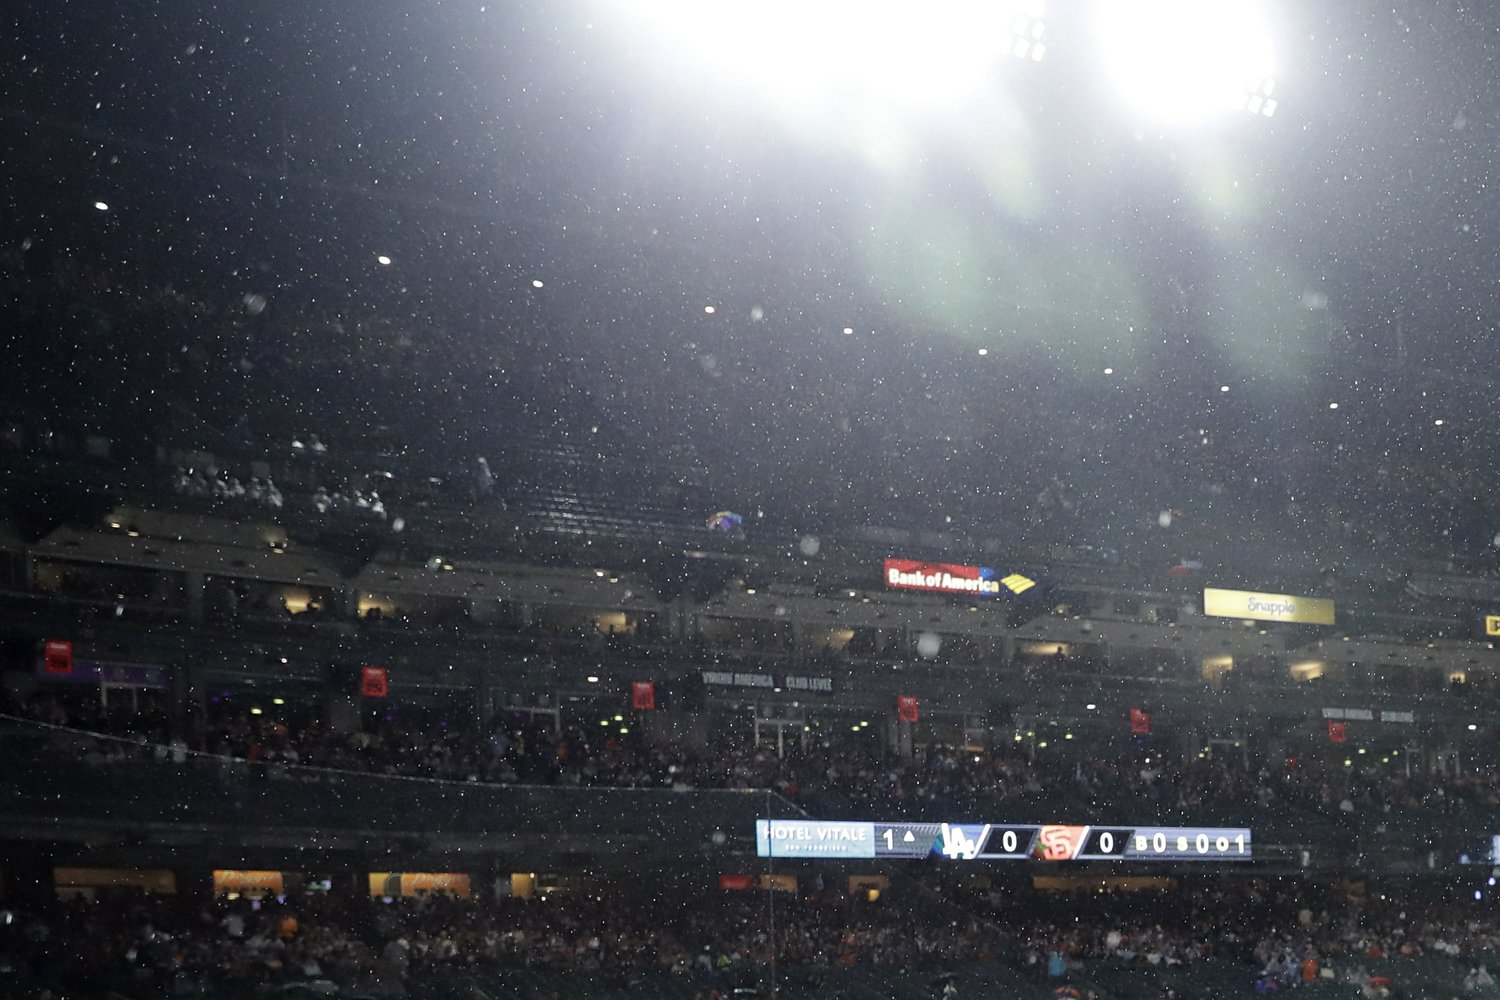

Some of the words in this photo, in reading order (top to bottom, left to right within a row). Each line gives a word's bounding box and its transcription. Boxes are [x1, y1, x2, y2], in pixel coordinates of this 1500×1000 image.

[888, 568, 926, 586] Bank
[926, 572, 942, 587] of
[942, 573, 1000, 592] America
[1247, 597, 1297, 615] Snapple
[763, 826, 812, 841] HOTEL
[816, 827, 867, 842] VITALE
[882, 829, 894, 850] 1
[1002, 830, 1017, 852] 0
[1099, 832, 1114, 853] 0
[1153, 832, 1167, 853] 0
[1196, 833, 1209, 853] 0
[1235, 834, 1245, 854] 1
